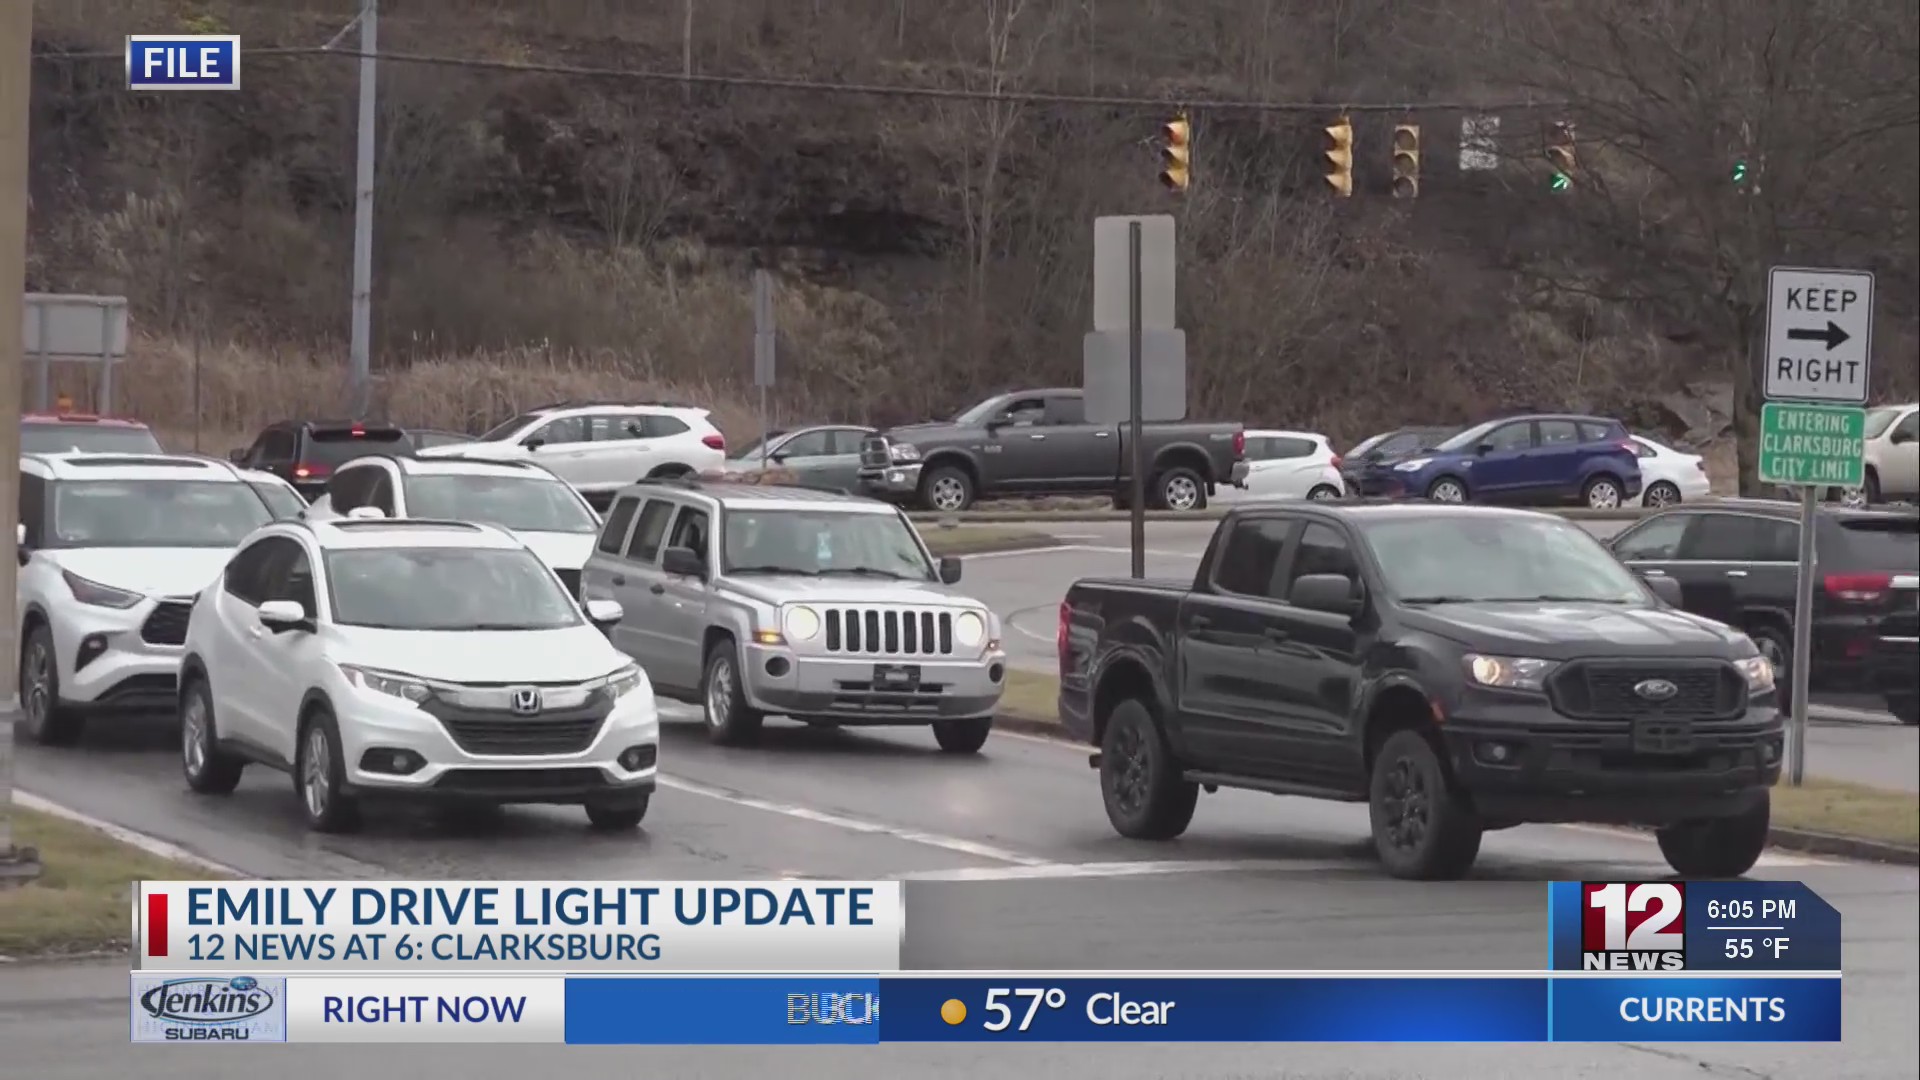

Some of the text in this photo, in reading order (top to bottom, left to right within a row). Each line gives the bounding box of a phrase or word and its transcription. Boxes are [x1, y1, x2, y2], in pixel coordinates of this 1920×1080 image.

[1786, 287, 1857, 312] KEEP
[1778, 357, 1859, 384] RIGHT
[1778, 410, 1850, 432] ENTERING
[1763, 434, 1862, 458] CLARKSBURG
[1772, 457, 1852, 480] CITY LIMIT
